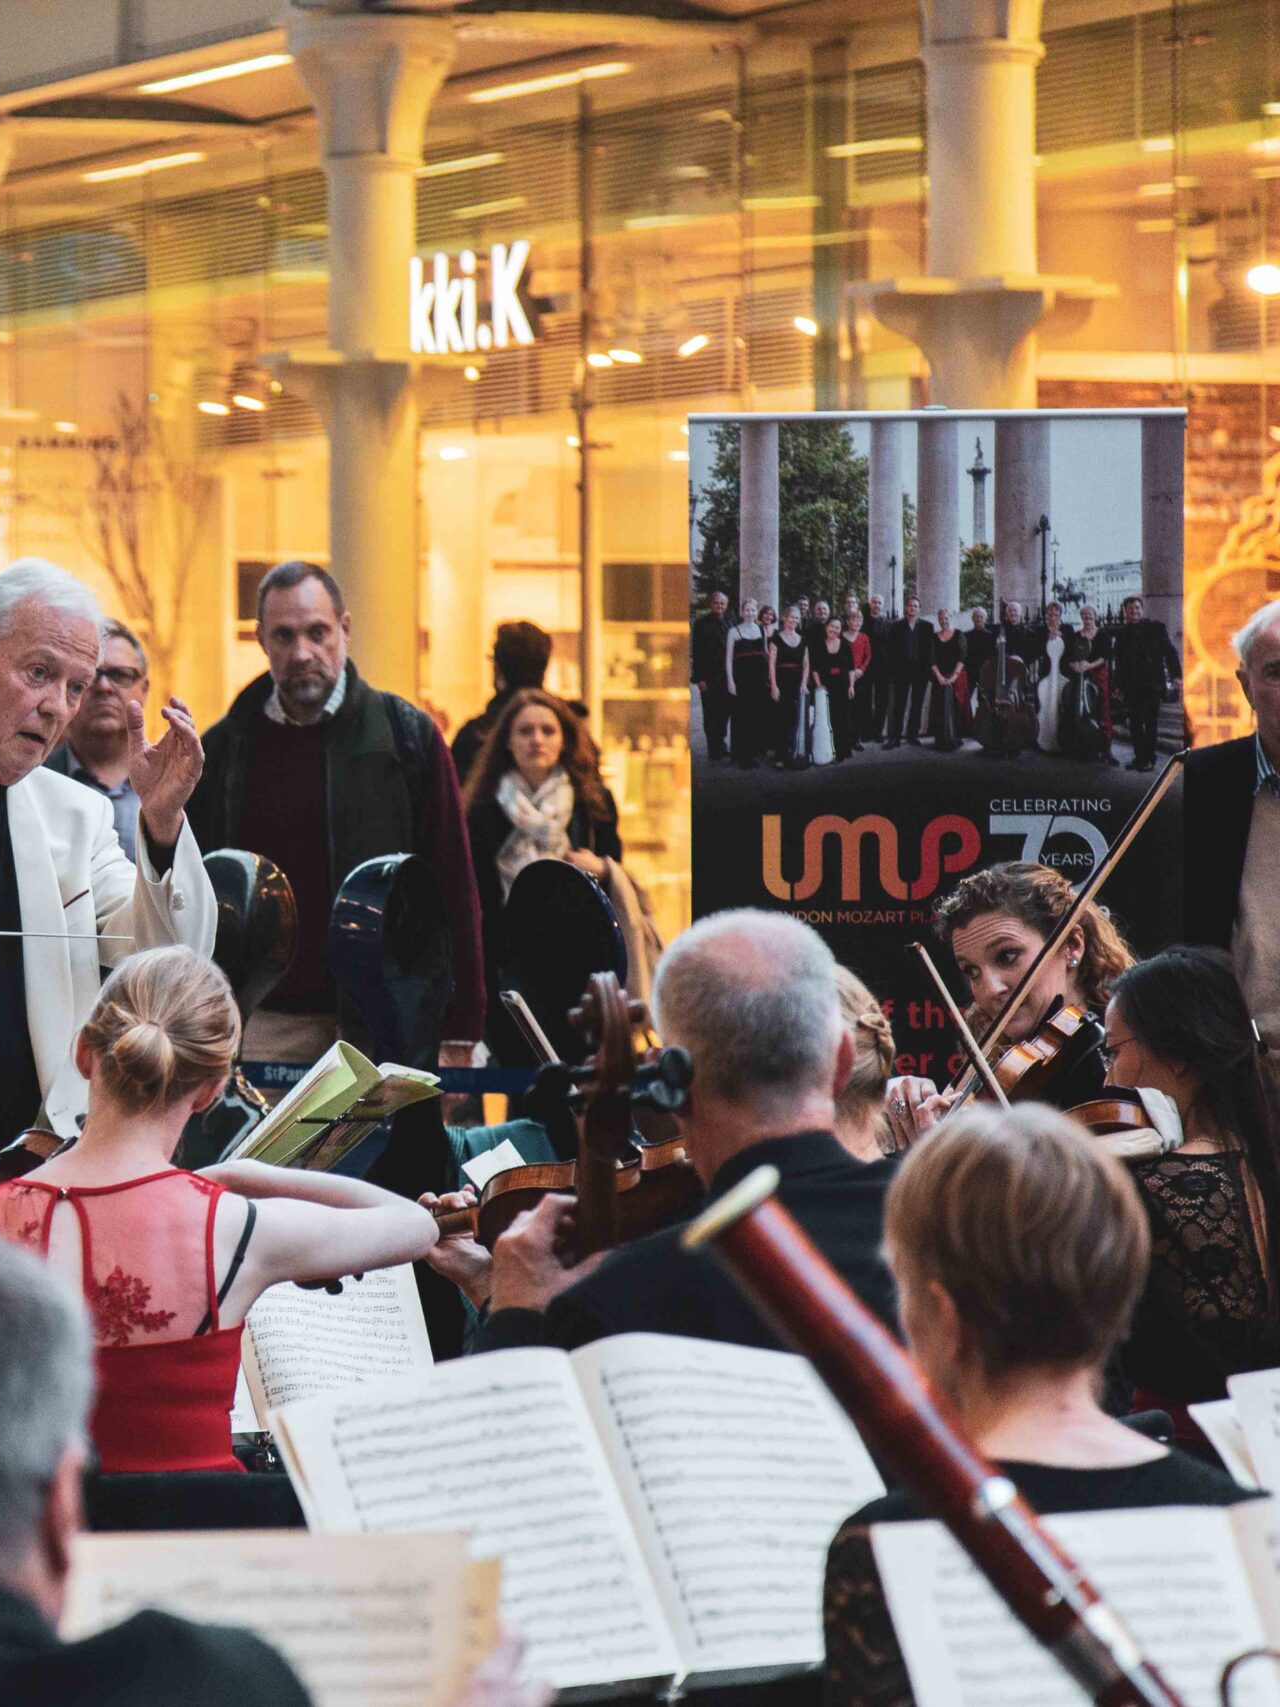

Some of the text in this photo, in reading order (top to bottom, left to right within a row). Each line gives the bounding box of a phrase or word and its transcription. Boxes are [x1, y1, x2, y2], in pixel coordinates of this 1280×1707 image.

[989, 799, 1111, 812] CELEBRATING
[1039, 852, 1094, 867] YEARS
[837, 911, 906, 924] MOZART
